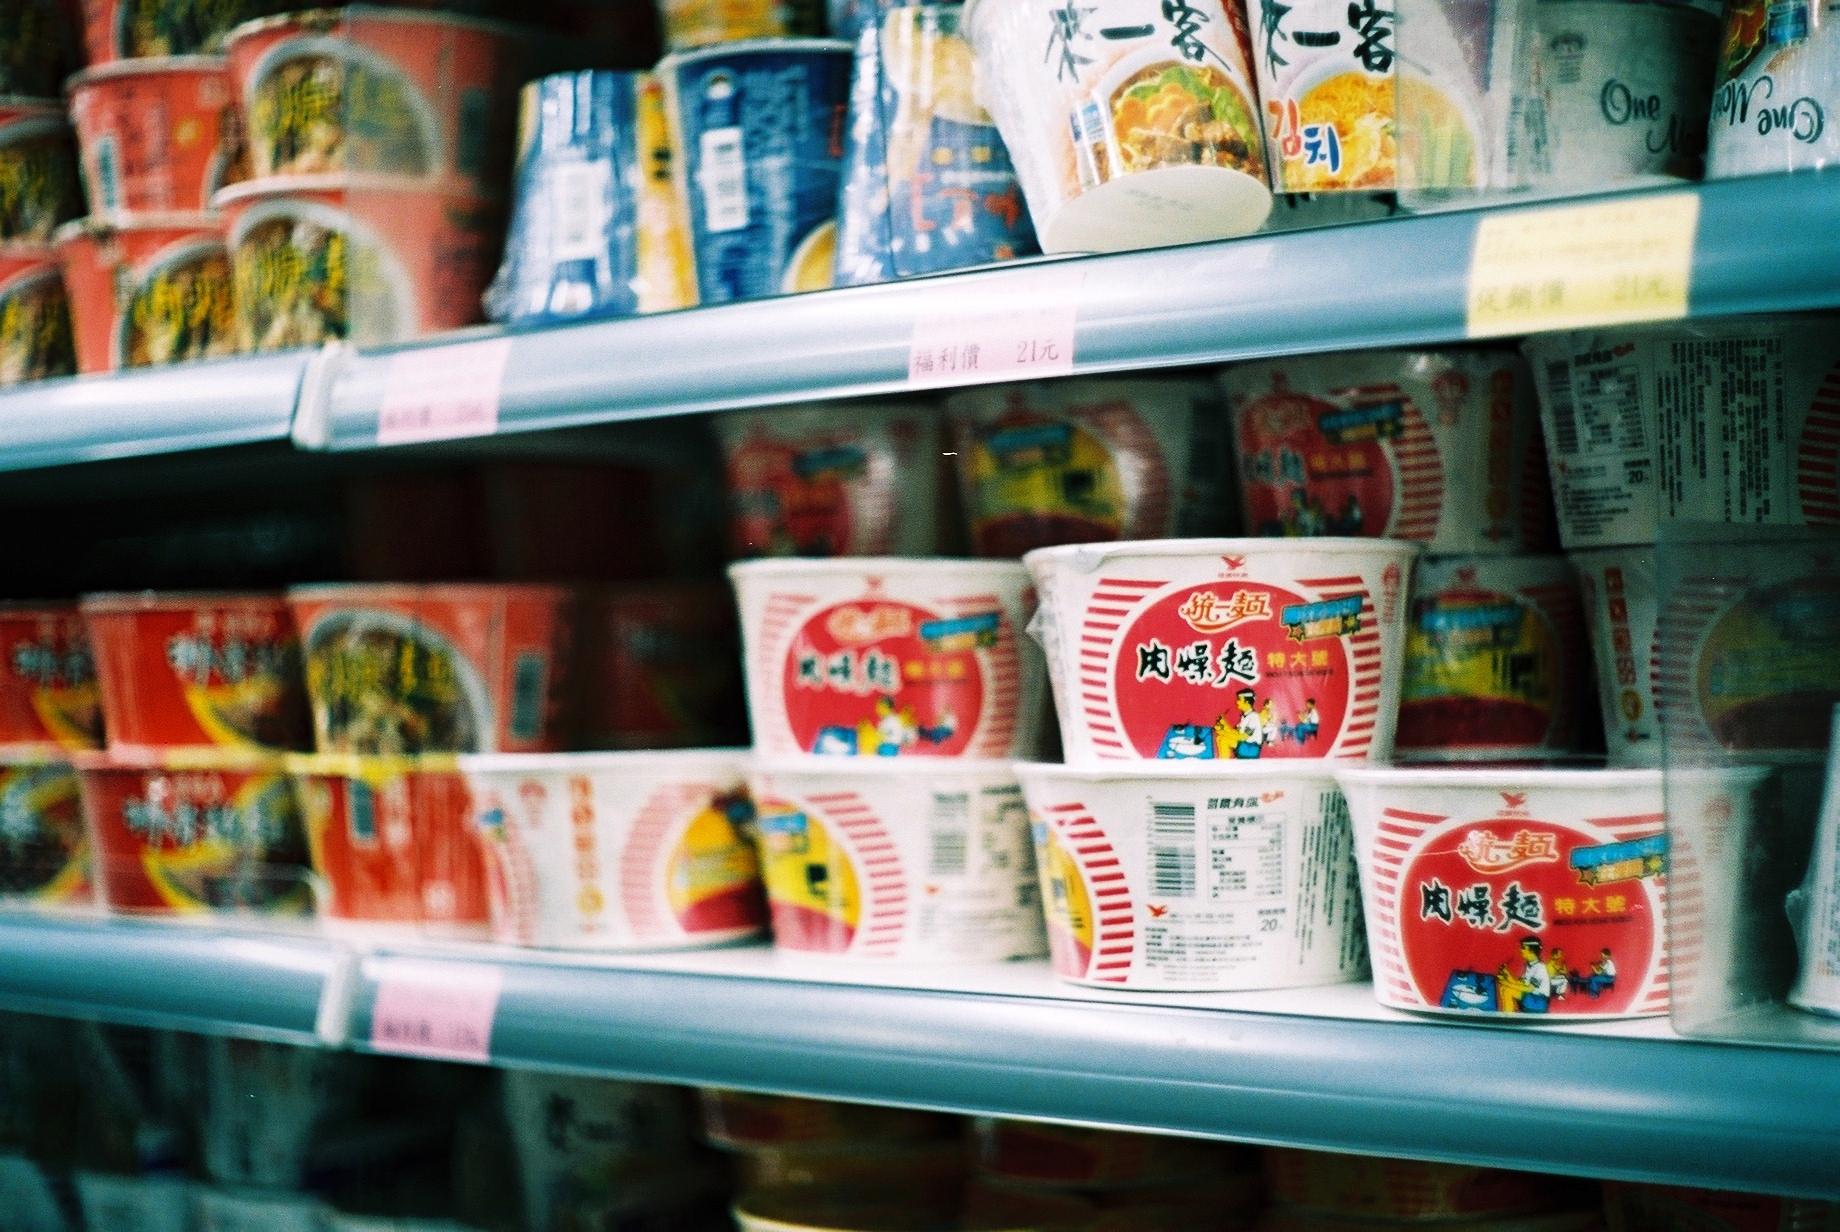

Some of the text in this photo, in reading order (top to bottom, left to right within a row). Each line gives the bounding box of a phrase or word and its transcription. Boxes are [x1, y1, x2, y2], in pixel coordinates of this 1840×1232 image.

[1600, 78, 1661, 125] One
[1757, 97, 1824, 143] One
[1267, 98, 1340, 173] 김치
[914, 339, 1059, 373] 福利價 21元
